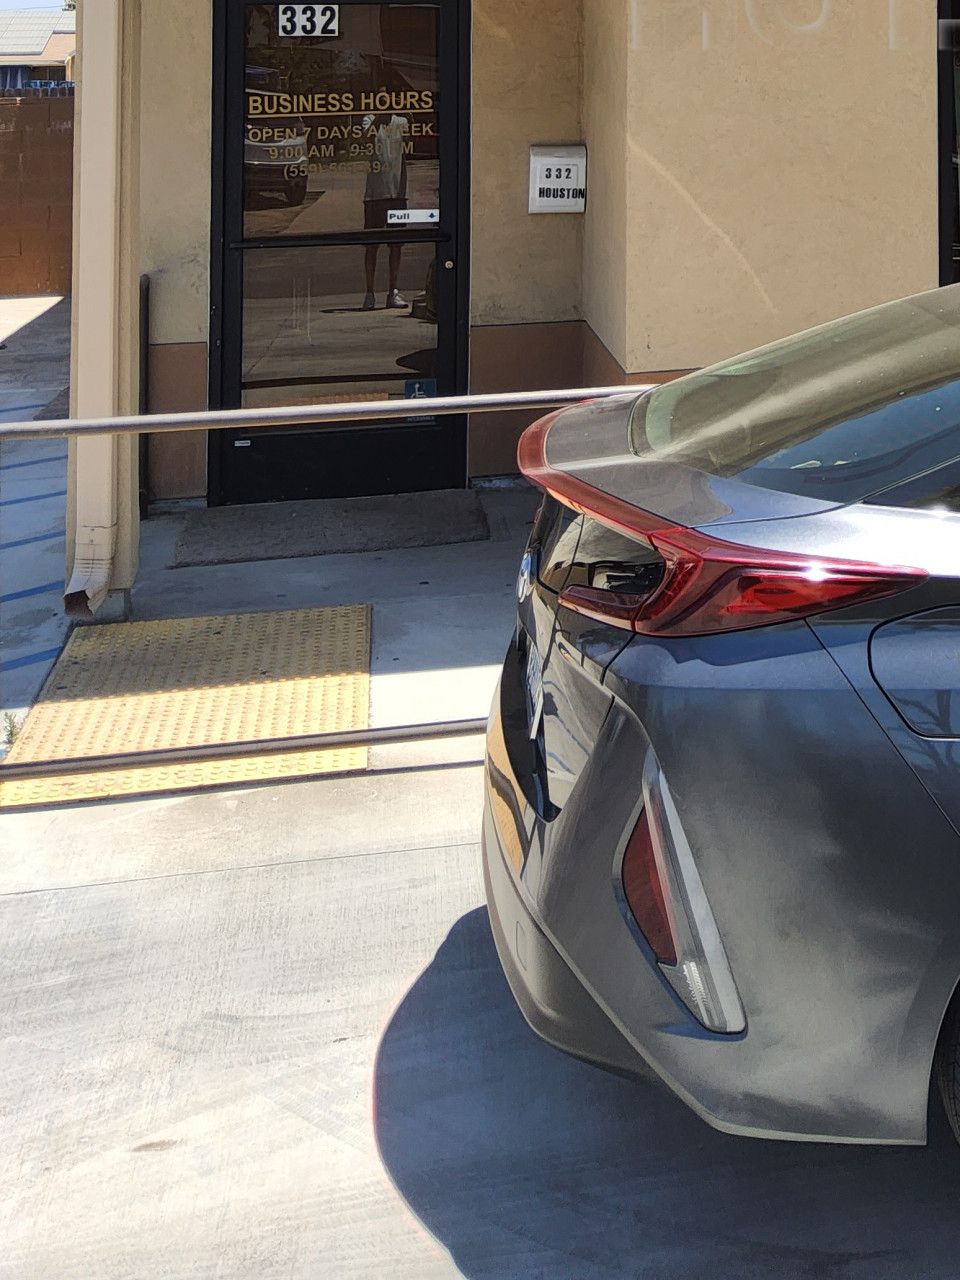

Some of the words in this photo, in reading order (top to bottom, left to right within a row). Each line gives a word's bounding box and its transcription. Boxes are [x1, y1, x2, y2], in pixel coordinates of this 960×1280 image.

[280, 5, 337, 36] 332
[248, 93, 355, 115] BUSINESS
[360, 90, 434, 111] HOURS
[248, 126, 298, 142] OPEN
[302, 126, 312, 141] 7
[317, 124, 363, 140] DAYS
[366, 123, 379, 138] A
[269, 145, 304, 160] 9:00
[308, 144, 335, 158] AM
[350, 142, 384, 157] 9:30
[544, 167, 572, 180] 332
[538, 186, 586, 200] HOUSTON
[388, 212, 411, 221] Pull
